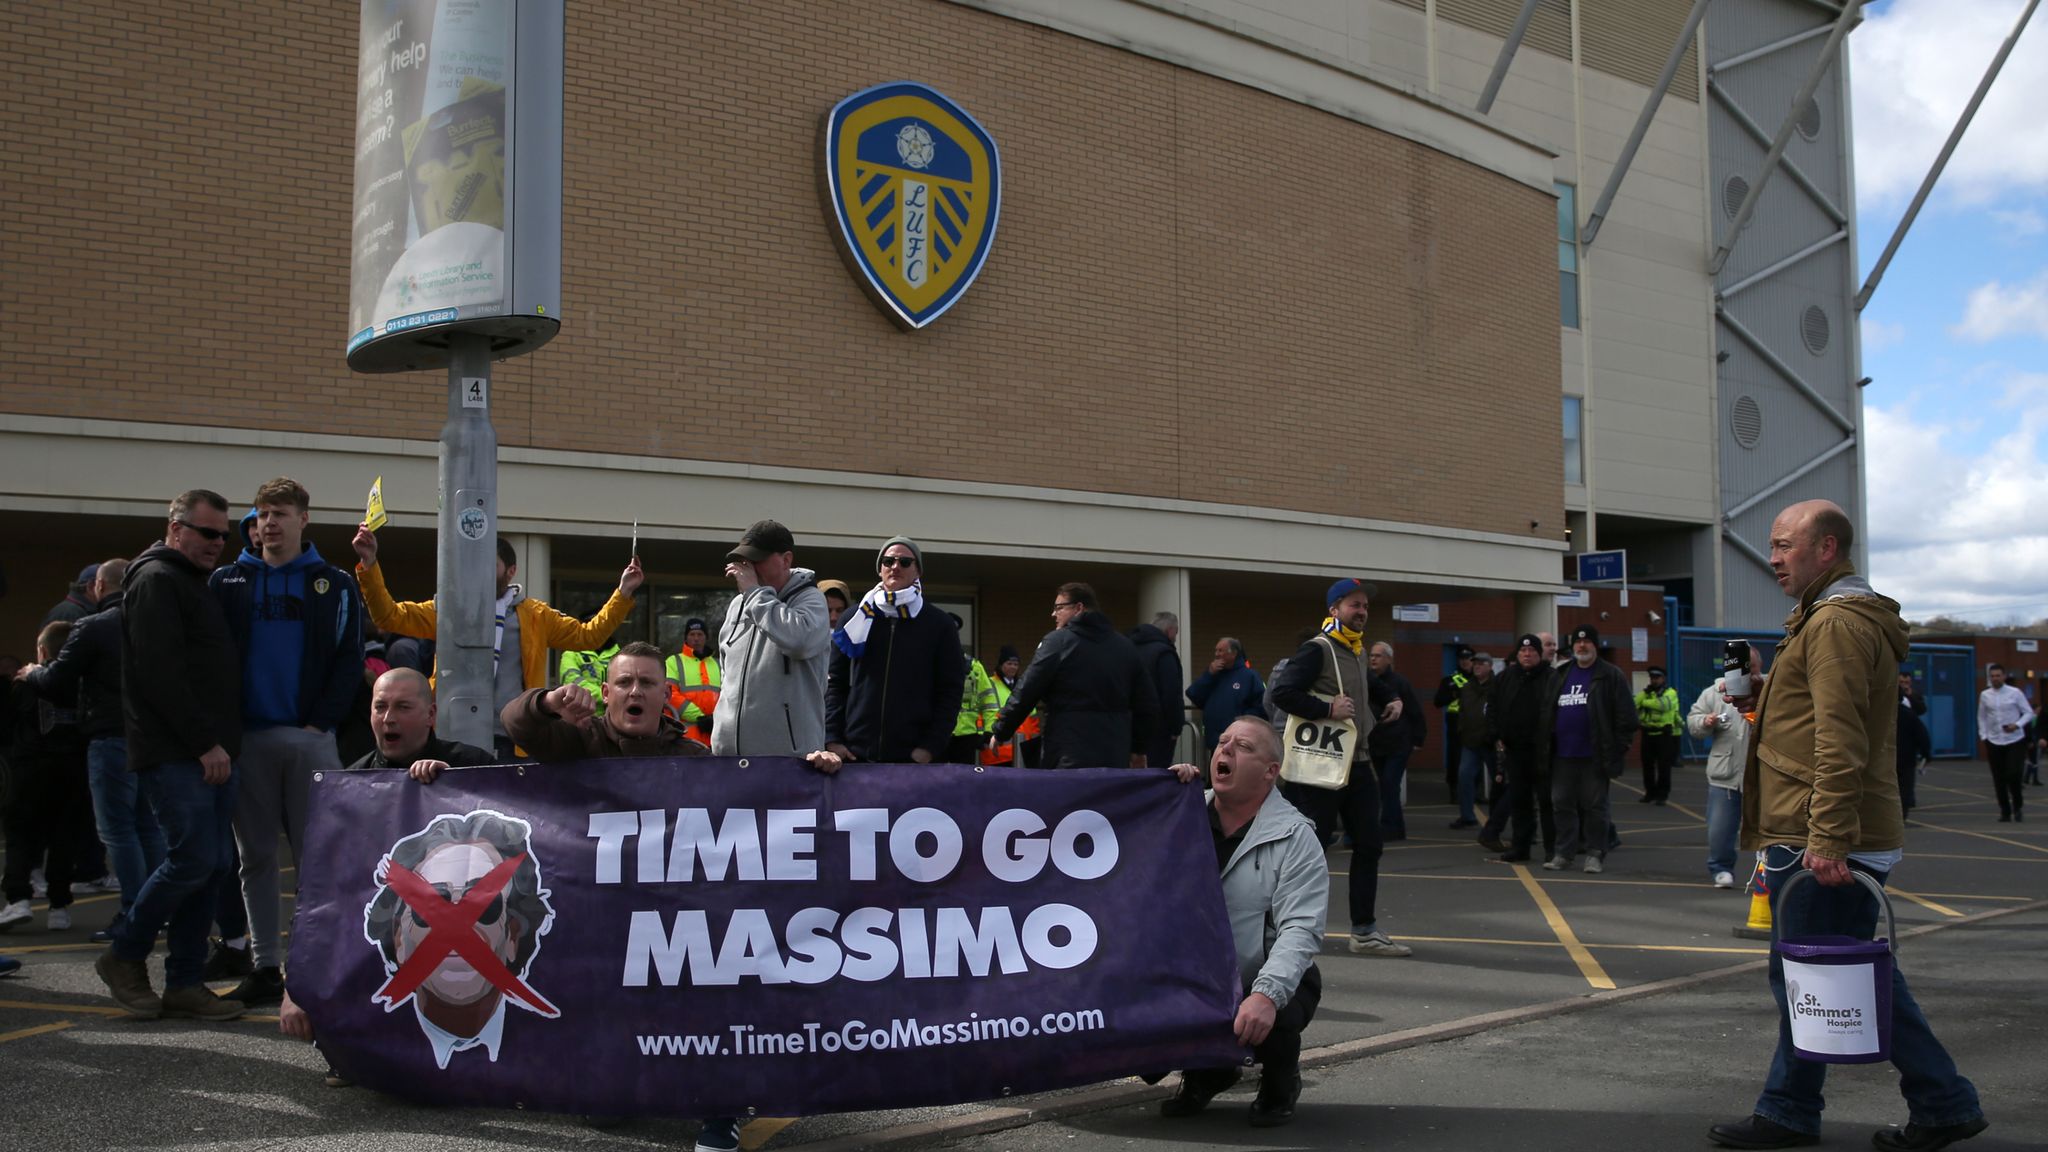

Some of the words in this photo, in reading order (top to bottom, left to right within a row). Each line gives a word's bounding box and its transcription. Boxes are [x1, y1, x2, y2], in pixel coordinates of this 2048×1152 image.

[391, 41, 426, 73] help
[466, 261, 482, 271] and
[461, 272, 495, 282] Service
[386, 321, 407, 331] 0113
[408, 316, 426, 326] 231
[428, 312, 454, 322] 0221
[470, 380, 481, 396] 4
[1571, 684, 1583, 694] 17
[1295, 722, 1349, 753] OK
[587, 808, 817, 883] TIME
[834, 807, 963, 882] TO
[982, 808, 1119, 882] GO
[622, 903, 1098, 987] MASSIMO
[1804, 993, 1821, 1007] St.
[1796, 1002, 1862, 1018] Gemma's
[636, 1008, 1105, 1056] www.TimeToGoMassimo.com
[1827, 1019, 1862, 1029] Hospice
